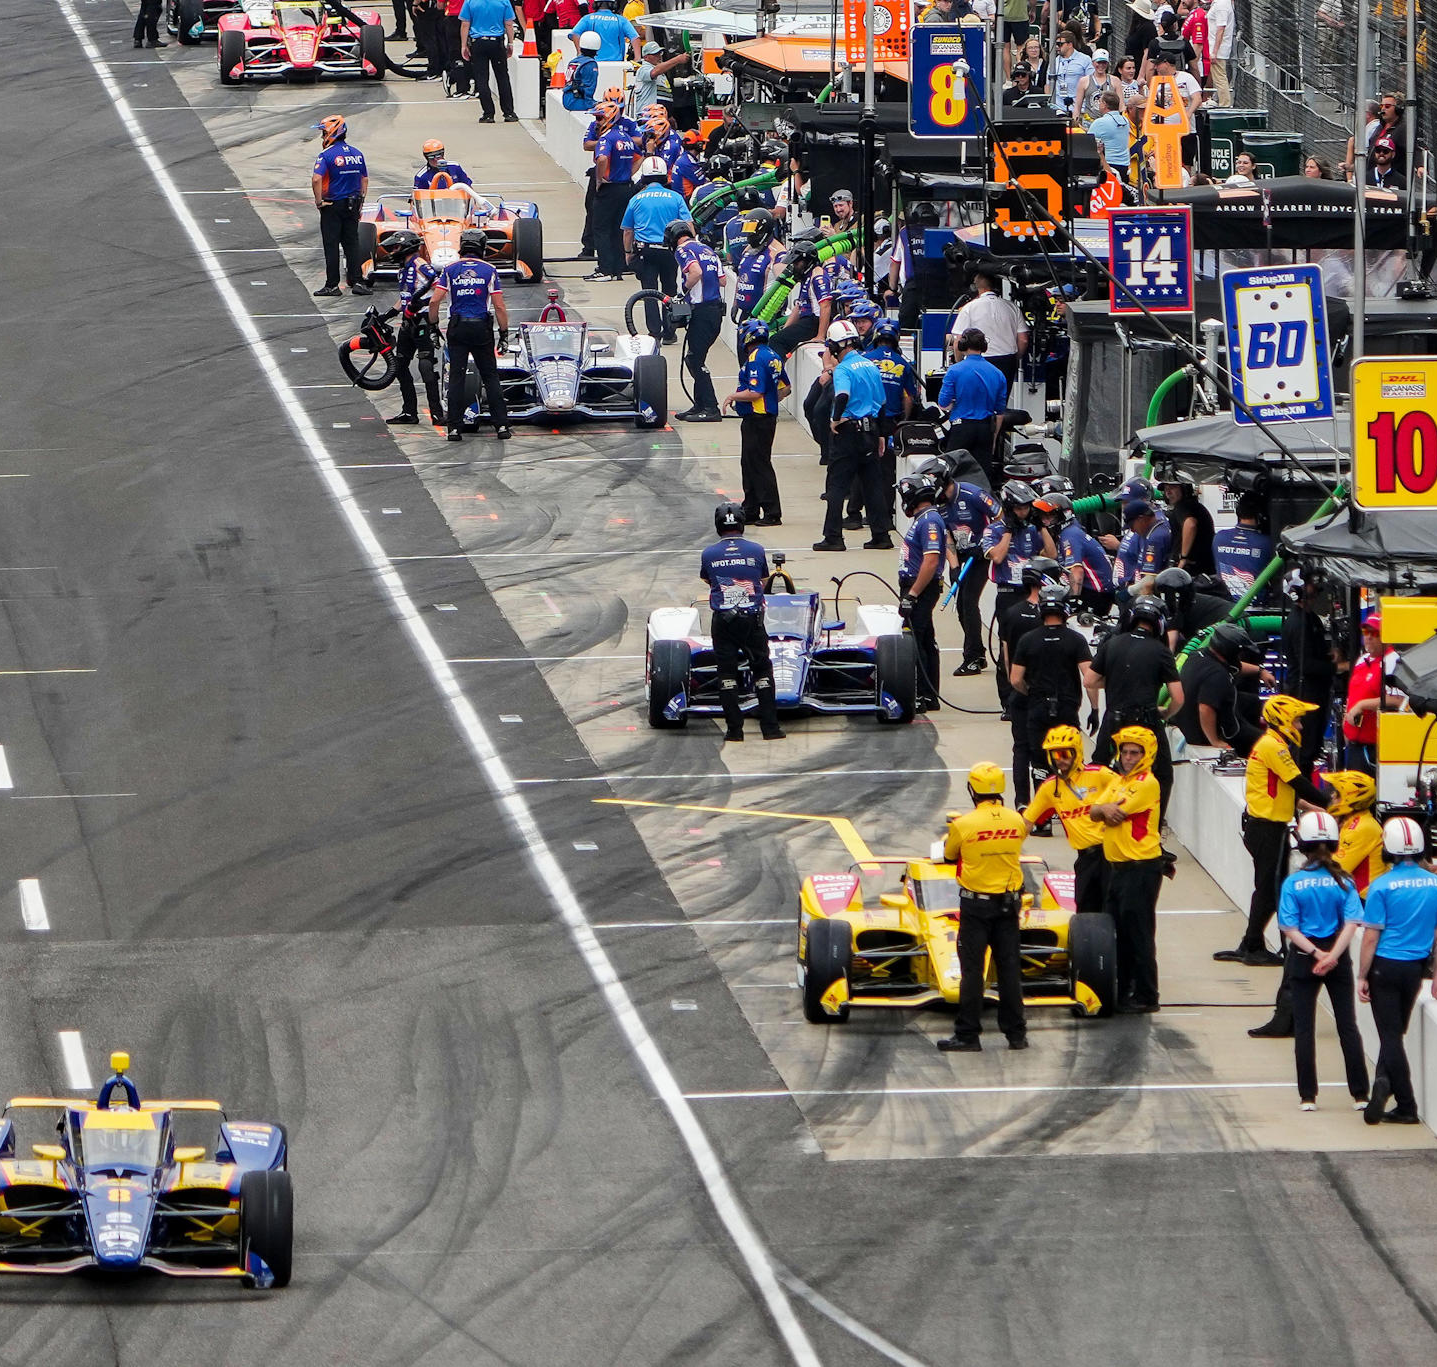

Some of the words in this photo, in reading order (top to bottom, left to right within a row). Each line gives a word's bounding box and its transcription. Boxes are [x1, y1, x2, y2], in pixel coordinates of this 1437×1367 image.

[928, 62, 968, 127] 8
[345, 155, 362, 165] PNC
[636, 190, 672, 199] OFFICIAL
[993, 140, 1063, 237] 5
[1374, 207, 1403, 215] TEAM
[1121, 235, 1179, 286] 14
[452, 276, 485, 287] Kingspan
[1248, 273, 1295, 285] SiriusXM
[531, 324, 576, 332] Kingspan
[1246, 319, 1308, 370] 60
[1388, 375, 1420, 383] DHL
[1260, 404, 1307, 418] SiriusXM
[725, 514, 735, 522] 14
[976, 828, 1020, 841] DHL
[107, 1189, 131, 1203] 8
